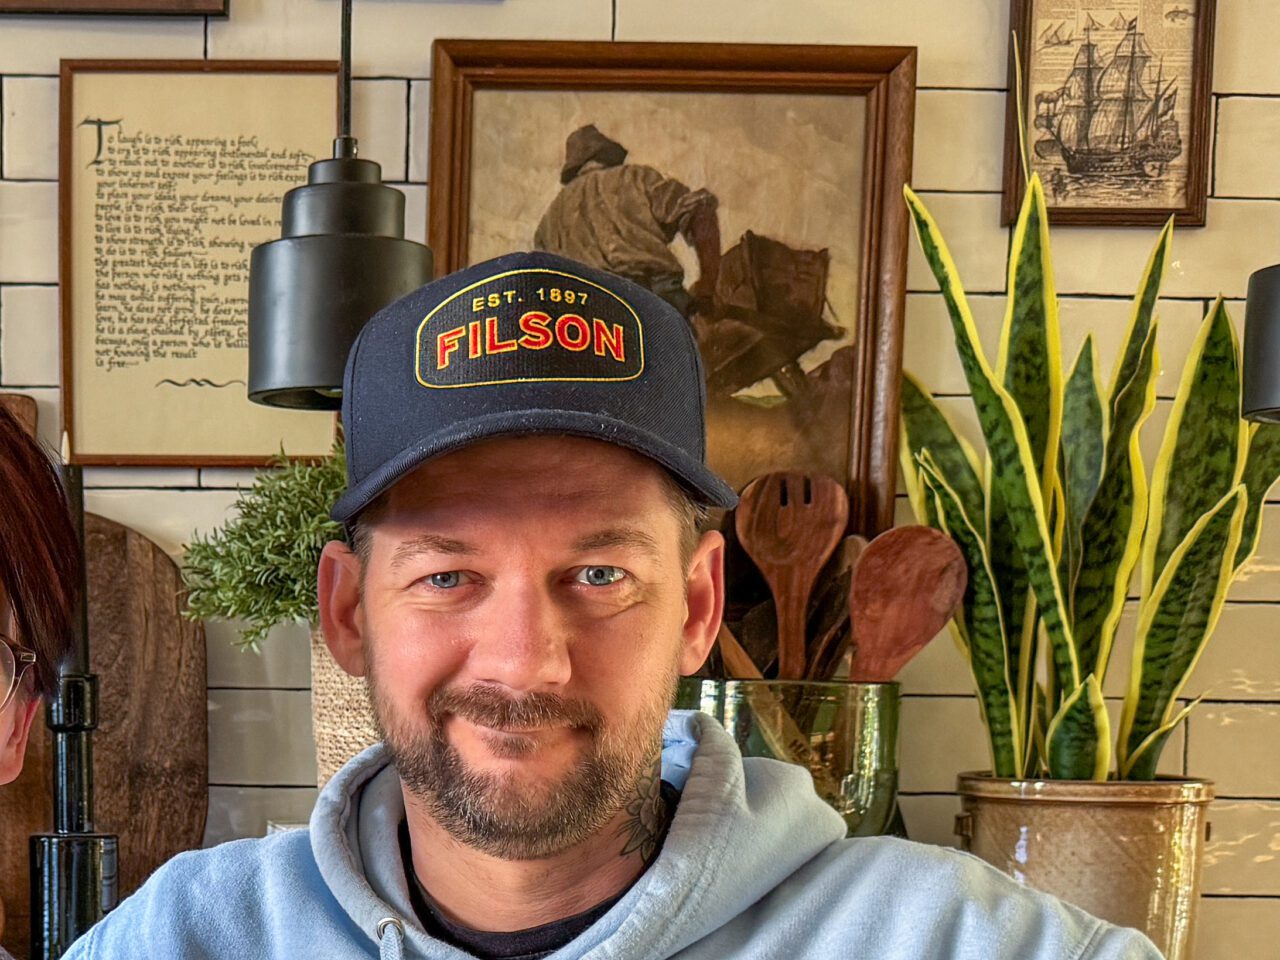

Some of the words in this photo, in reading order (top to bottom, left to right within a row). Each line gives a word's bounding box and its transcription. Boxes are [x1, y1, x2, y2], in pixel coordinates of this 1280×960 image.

[118, 125, 144, 148] laugh
[145, 133, 153, 144] is
[154, 136, 164, 145] to
[165, 134, 184, 146] risk
[186, 137, 226, 151] appearing
[230, 139, 236, 147] a
[107, 146, 116, 155] to
[117, 147, 131, 160] cry
[133, 147, 141, 156] is
[142, 147, 150, 156] to
[152, 146, 172, 157] risk
[174, 148, 217, 161] appearing
[219, 148, 269, 159] sentimental
[271, 149, 287, 160] and
[108, 159, 117, 168] to
[119, 157, 142, 168] reach
[161, 160, 170, 168] to
[173, 158, 205, 169] another
[207, 160, 216, 170] is
[218, 161, 227, 170] to
[228, 160, 247, 171] risk
[95, 168, 105, 177] to
[107, 167, 129, 178] show
[131, 169, 143, 181] up
[144, 168, 160, 178] and
[162, 171, 190, 181] expose
[193, 172, 215, 185] your
[214, 170, 248, 186] feelings
[249, 171, 258, 182] is
[259, 173, 268, 182] to
[268, 171, 284, 182] risk
[284, 173, 306, 185] expos
[96, 181, 117, 195] your
[119, 179, 155, 189] inherent
[95, 191, 105, 200] to
[107, 189, 129, 202] place
[131, 194, 153, 205] your
[178, 194, 200, 208] your
[233, 196, 255, 209] your
[125, 202, 134, 212] is
[135, 204, 145, 212] to
[146, 202, 166, 214] risk
[167, 202, 189, 213] their
[95, 213, 104, 222] to
[105, 211, 123, 222] love
[124, 213, 132, 222] is
[133, 214, 143, 222] to
[144, 212, 163, 225] risk
[163, 217, 181, 230] you
[182, 214, 208, 232] might
[211, 217, 227, 226] not
[228, 214, 238, 226] be
[239, 214, 262, 227] loved
[263, 217, 273, 227] in
[95, 223, 105, 233] to
[124, 224, 133, 233] is
[134, 224, 143, 233] to
[144, 224, 164, 238] risk
[95, 235, 104, 244] to
[106, 234, 128, 245] show
[129, 236, 165, 252] strength
[167, 237, 176, 247] is
[177, 239, 186, 247] to
[187, 236, 206, 249] risk
[209, 236, 245, 254] showing
[95, 247, 103, 255] to
[105, 245, 117, 256] do
[119, 246, 127, 256] is
[128, 248, 138, 256] to
[140, 247, 160, 259] risk
[95, 255, 109, 267] the
[111, 259, 145, 275] greatest
[147, 258, 178, 270] hazard
[181, 260, 192, 269] in
[192, 256, 208, 270] life
[210, 260, 219, 270] is
[220, 261, 230, 270] to
[230, 259, 248, 272] risk
[95, 266, 109, 278] the
[111, 271, 141, 283] person
[143, 268, 161, 278] who
[185, 270, 220, 286] nothing
[223, 273, 242, 287] gets
[95, 279, 110, 290] has
[152, 281, 160, 292] is
[95, 291, 105, 301] he
[108, 294, 128, 304] may
[472, 289, 524, 312] EST.
[535, 287, 589, 306] 1897
[135, 303, 155, 313] does
[157, 305, 172, 315] not
[200, 303, 211, 314] he
[213, 304, 232, 315] does
[118, 312, 128, 323] he
[130, 313, 145, 324] has
[95, 324, 105, 335] he
[107, 325, 116, 335] is
[117, 327, 125, 335] a
[187, 327, 200, 341] by
[436, 310, 626, 371] FILSON
[152, 340, 159, 348] a
[160, 339, 189, 351] person
[191, 339, 211, 349] who
[213, 338, 223, 349] is
[224, 338, 249, 349] willi
[95, 347, 112, 357] not
[113, 346, 151, 363] knowing
[152, 346, 167, 359] the
[170, 348, 198, 359] result
[95, 357, 105, 368] is
